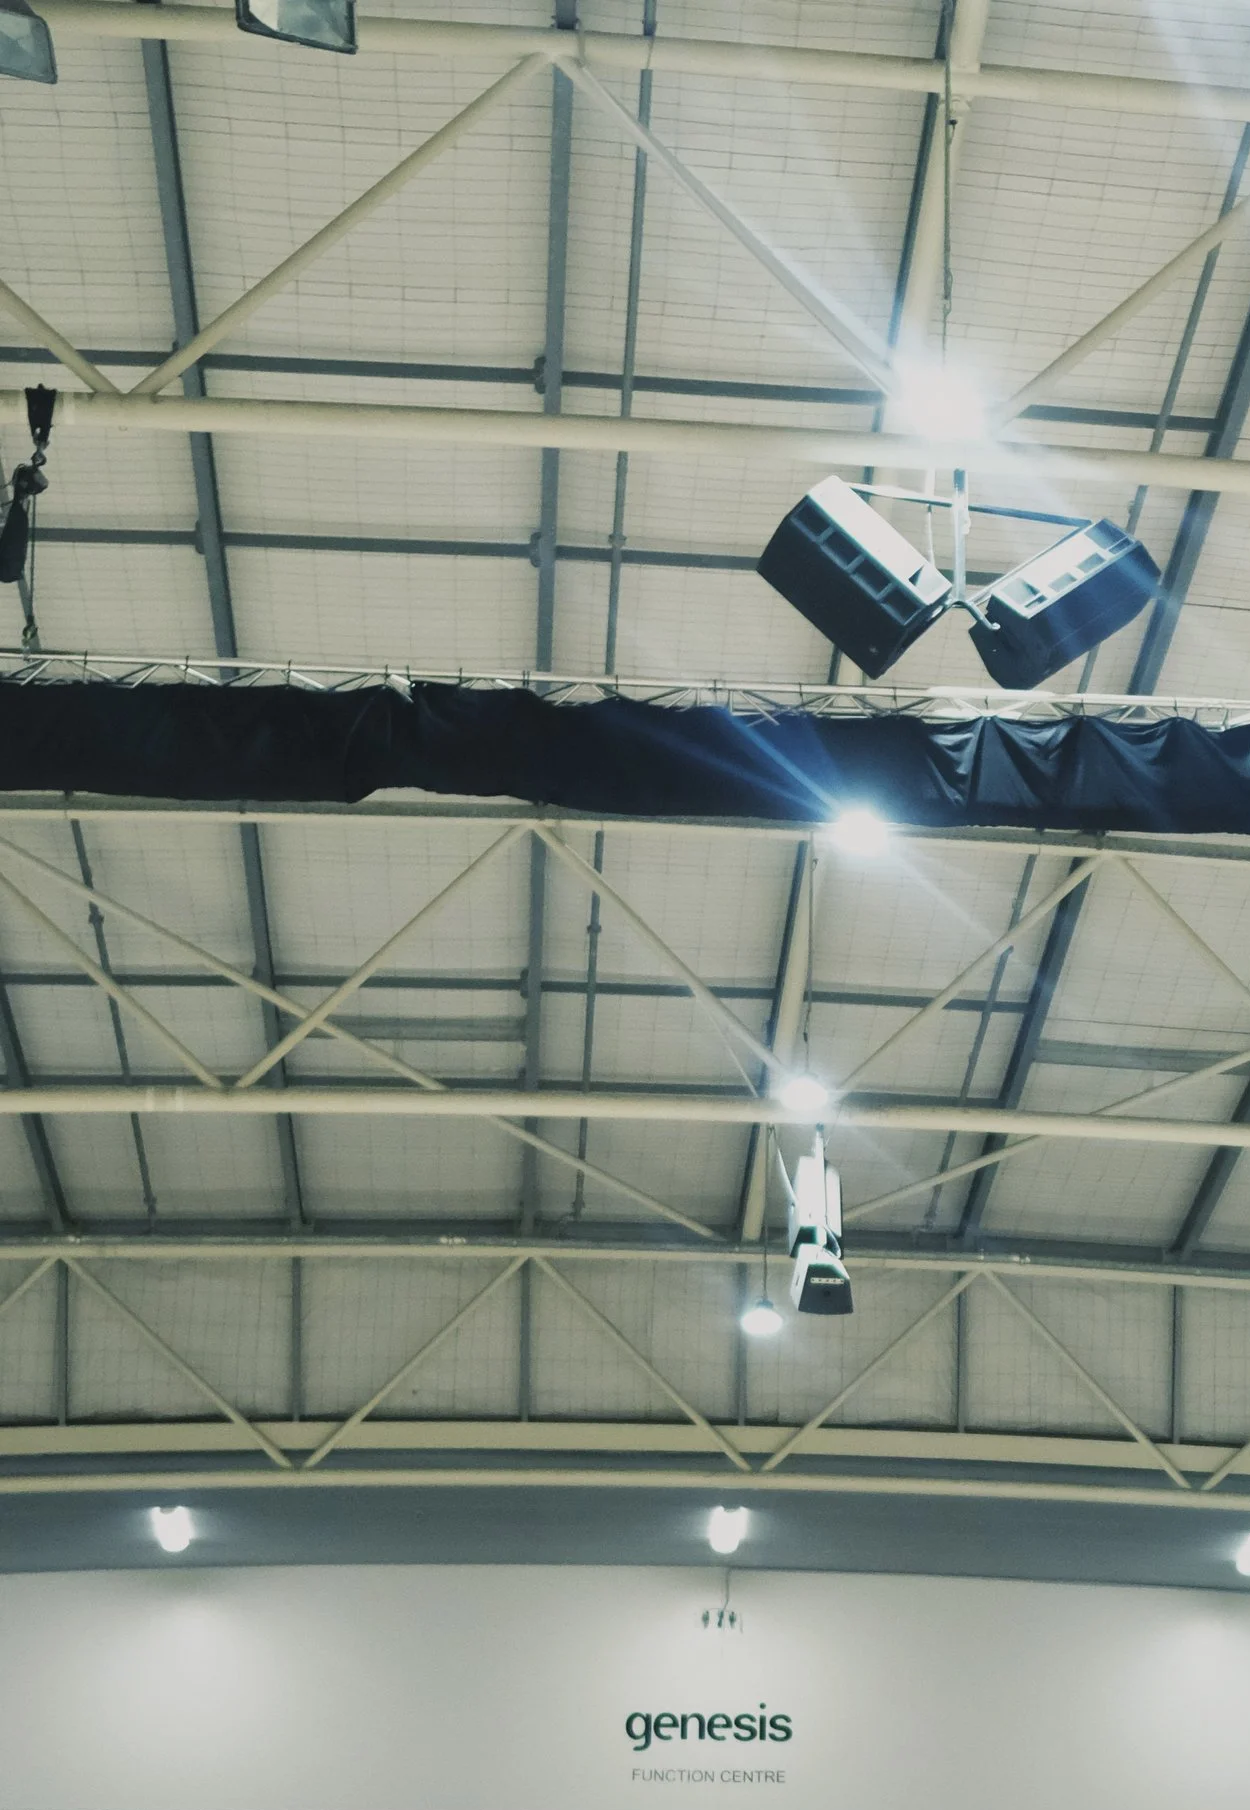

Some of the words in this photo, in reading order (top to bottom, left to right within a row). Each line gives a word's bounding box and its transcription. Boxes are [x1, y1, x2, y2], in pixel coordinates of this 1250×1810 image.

[625, 1702, 793, 1752] genesis
[631, 1768, 715, 1783] FUNCTION
[720, 1770, 786, 1784] CENTRE
